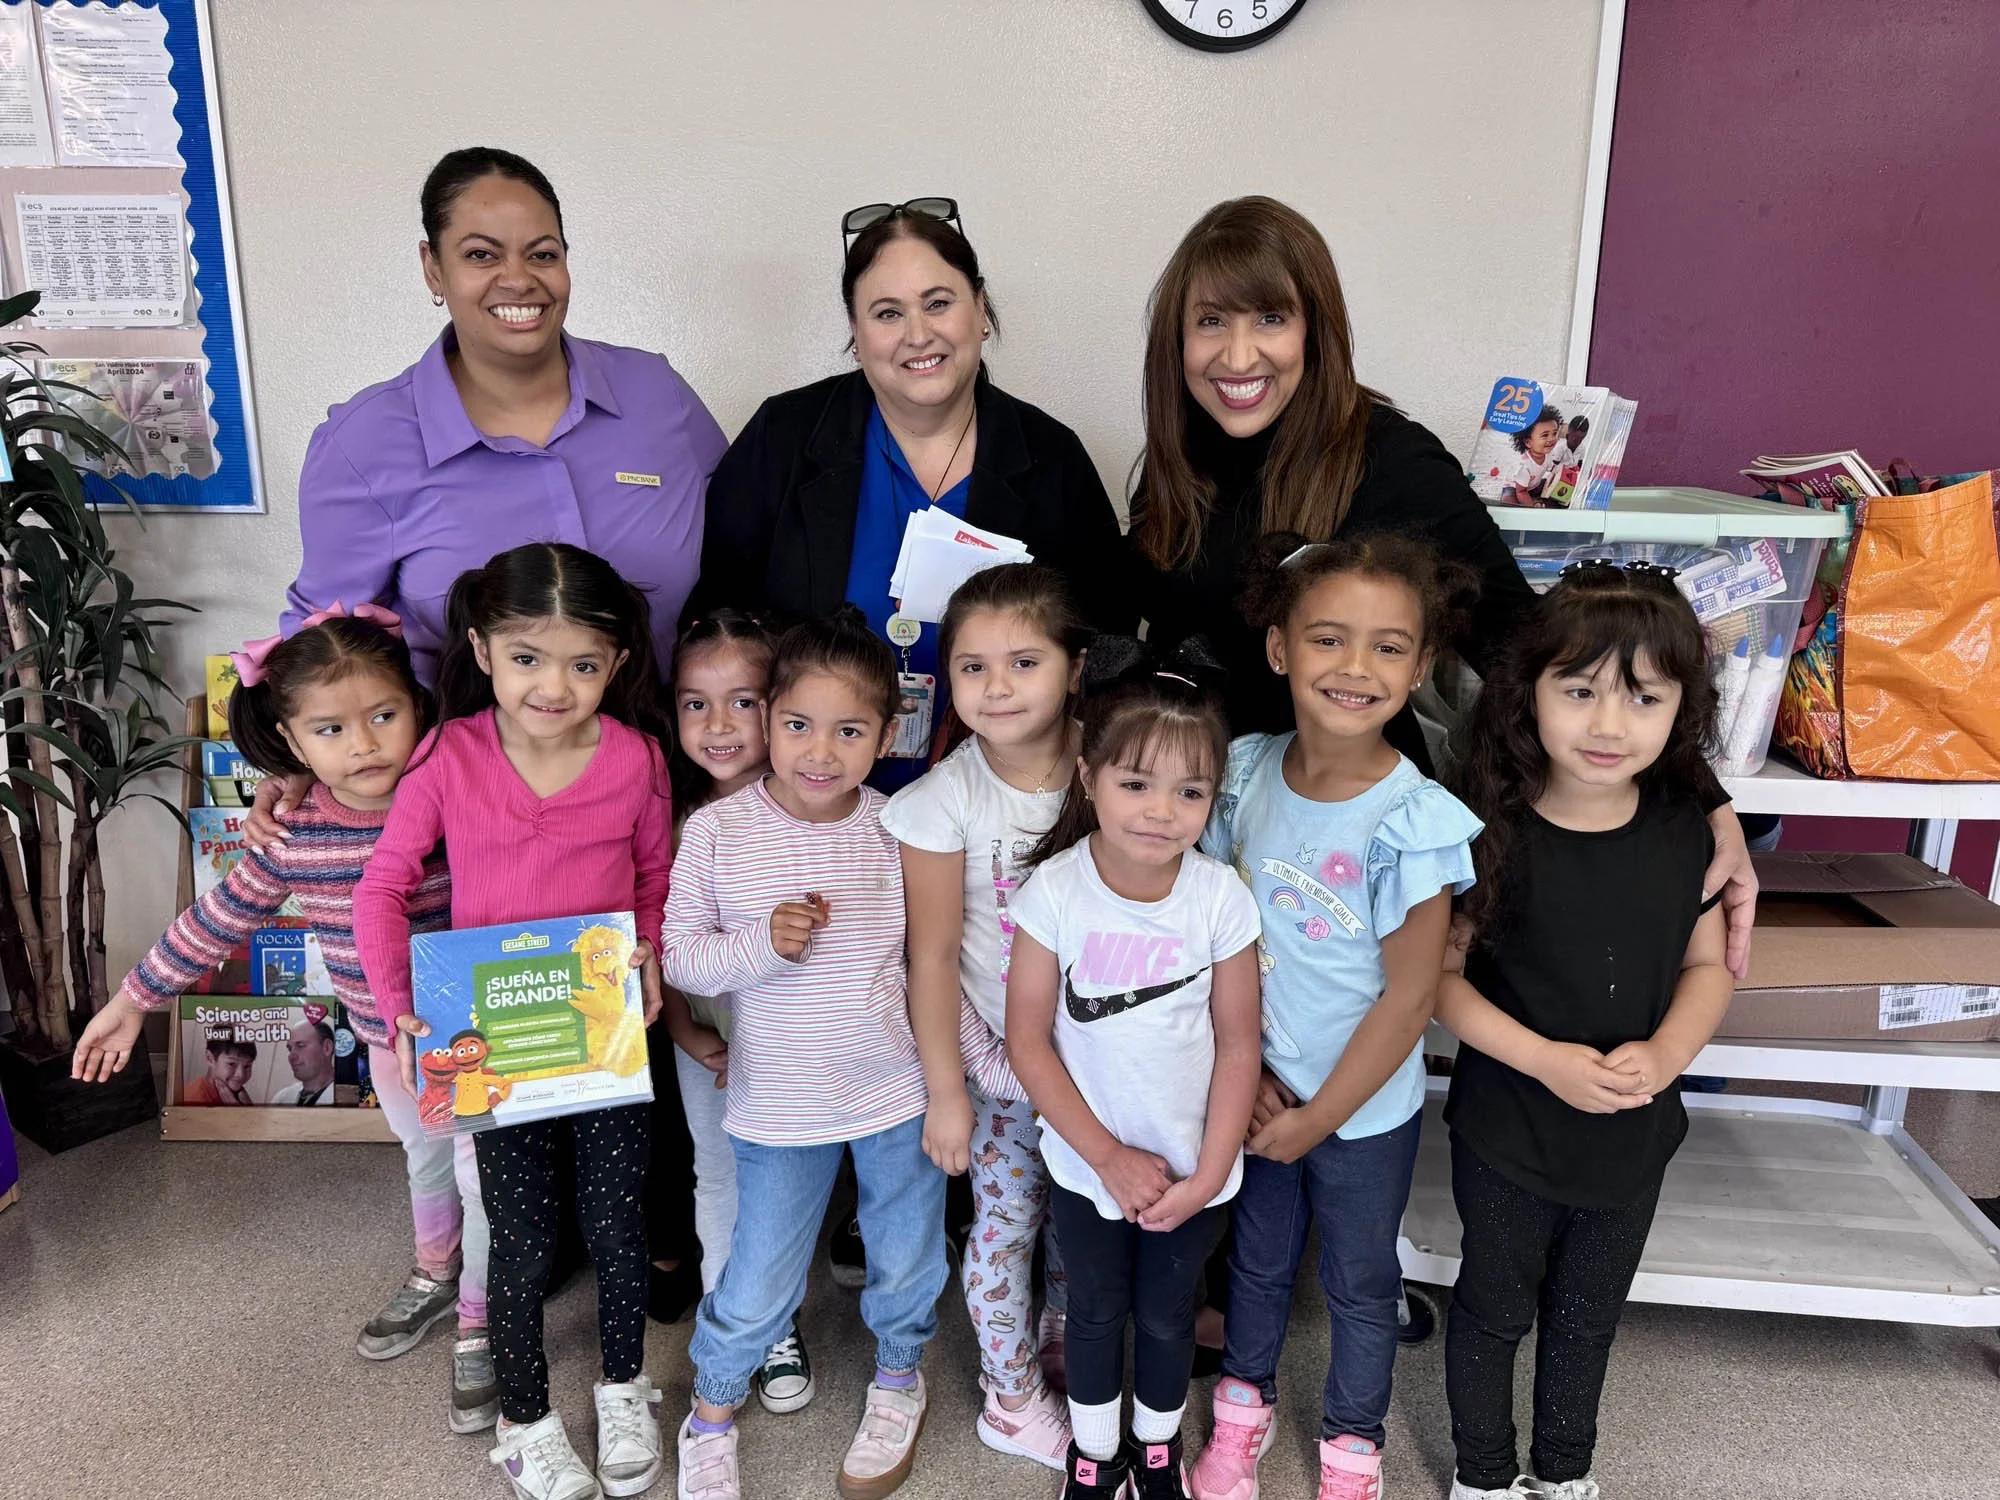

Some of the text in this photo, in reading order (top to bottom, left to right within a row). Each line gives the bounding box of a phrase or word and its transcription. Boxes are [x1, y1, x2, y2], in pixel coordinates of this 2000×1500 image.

[1185, 0, 1198, 19] 7
[1217, 9, 1233, 29] 6
[1252, 0, 1268, 19] 5
[27, 202, 43, 210] ecs
[59, 364, 77, 373] ecs
[107, 368, 125, 376] April
[1494, 384, 1533, 414] 25
[1489, 416, 1527, 428] Early Learning
[1507, 412, 1518, 420] Tips
[232, 761, 266, 779] How
[1273, 862, 1355, 926] ULTIMATE FRIENDSHIP GOALS
[1071, 931, 1185, 987] NIKE
[486, 968, 570, 994] ¡SUEÑA EN
[486, 984, 572, 1009] GRANDE!
[195, 1006, 288, 1023] Science and
[234, 1024, 292, 1043] Health
